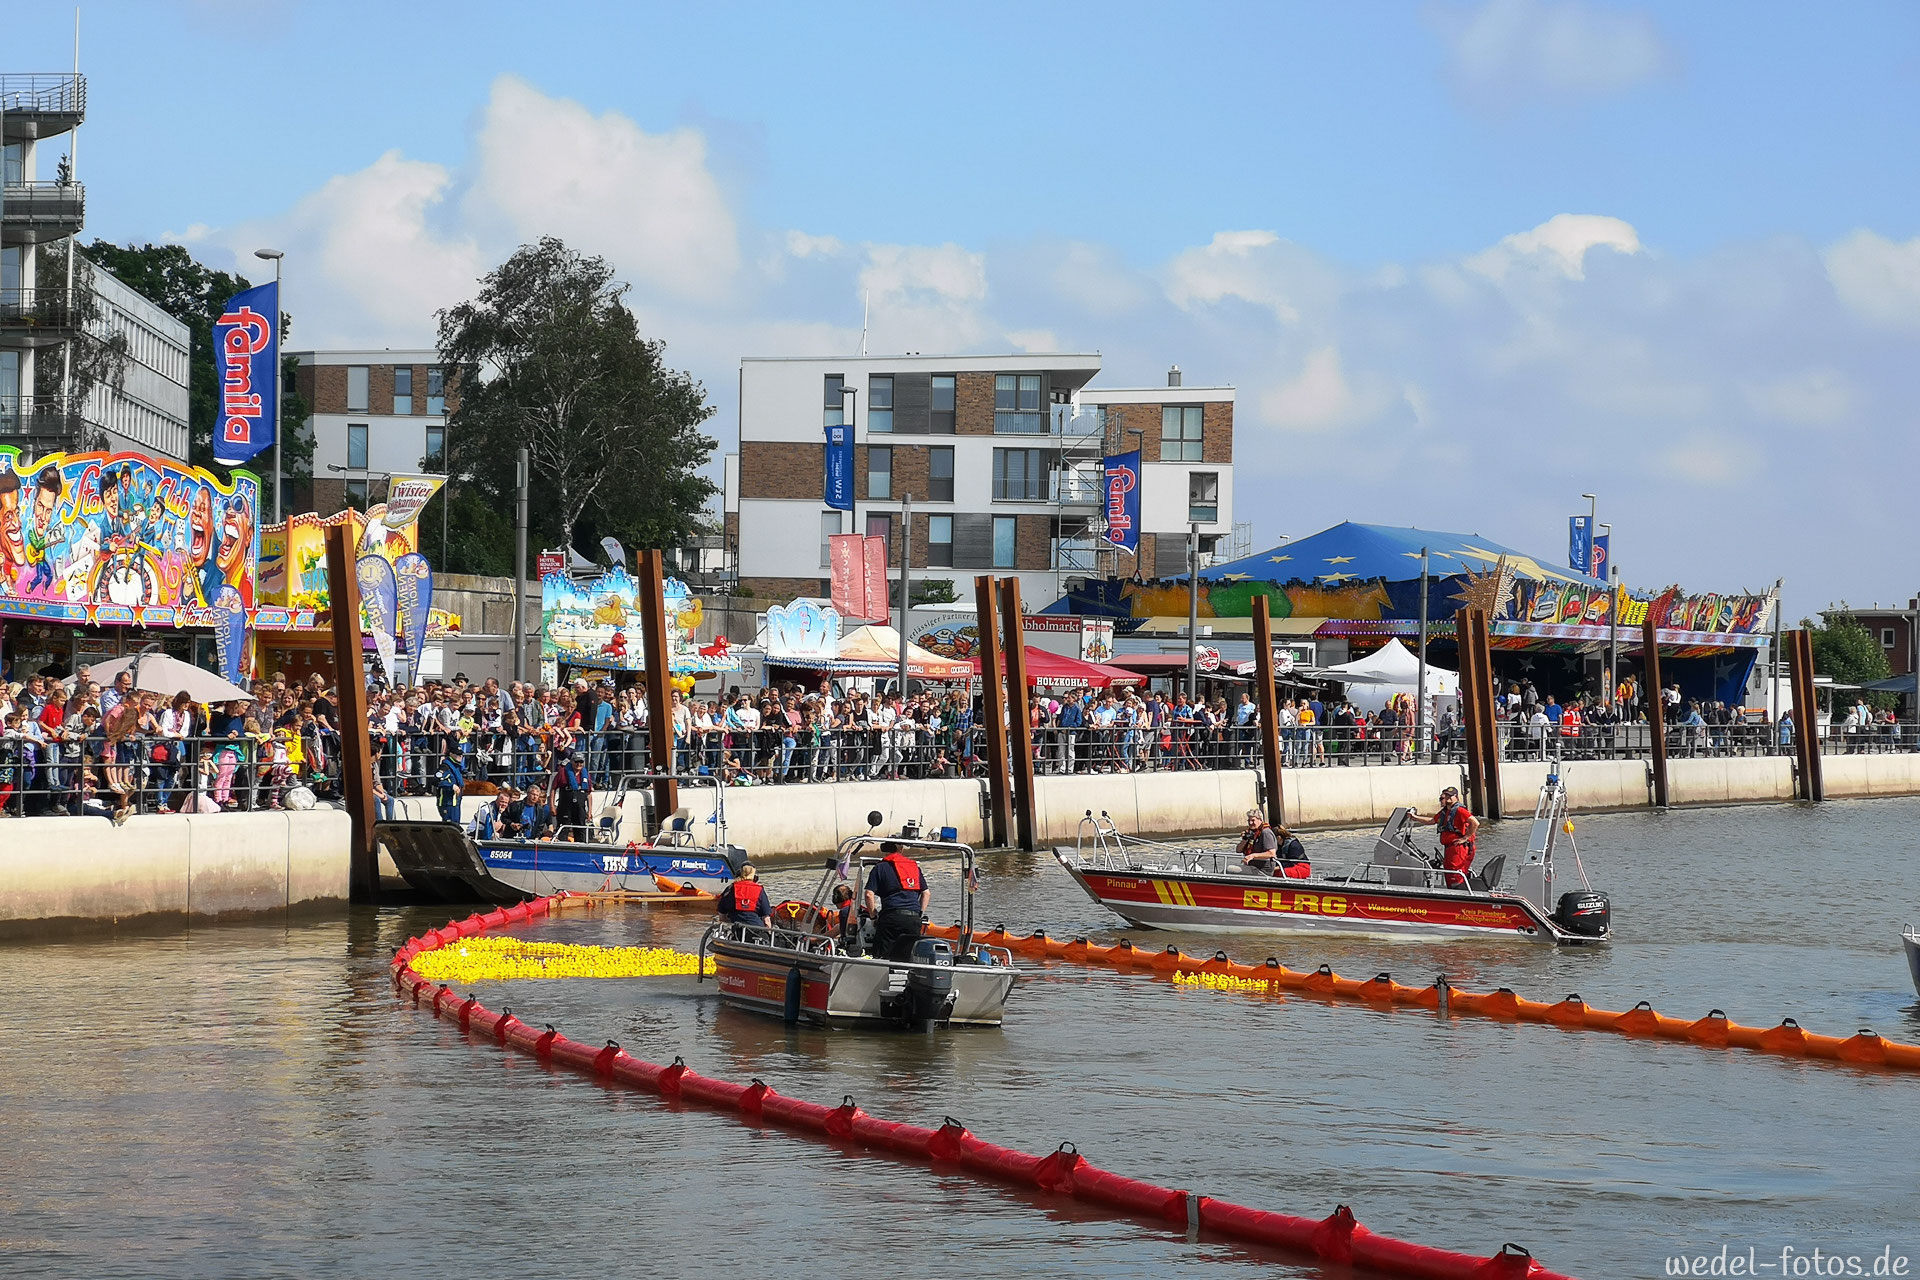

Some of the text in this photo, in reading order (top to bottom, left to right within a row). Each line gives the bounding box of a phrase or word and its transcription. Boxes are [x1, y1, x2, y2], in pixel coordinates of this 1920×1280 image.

[216, 306, 271, 444] famila
[153, 477, 190, 519] Club
[391, 485, 434, 498] Twister
[1105, 464, 1136, 542] famila
[908, 615, 941, 641] erlässiger
[1036, 676, 1089, 687] HOLZKOHLE
[1106, 878, 1137, 889] Pinnau
[1243, 889, 1348, 915] DLRG
[1576, 901, 1604, 909] SUZUKI
